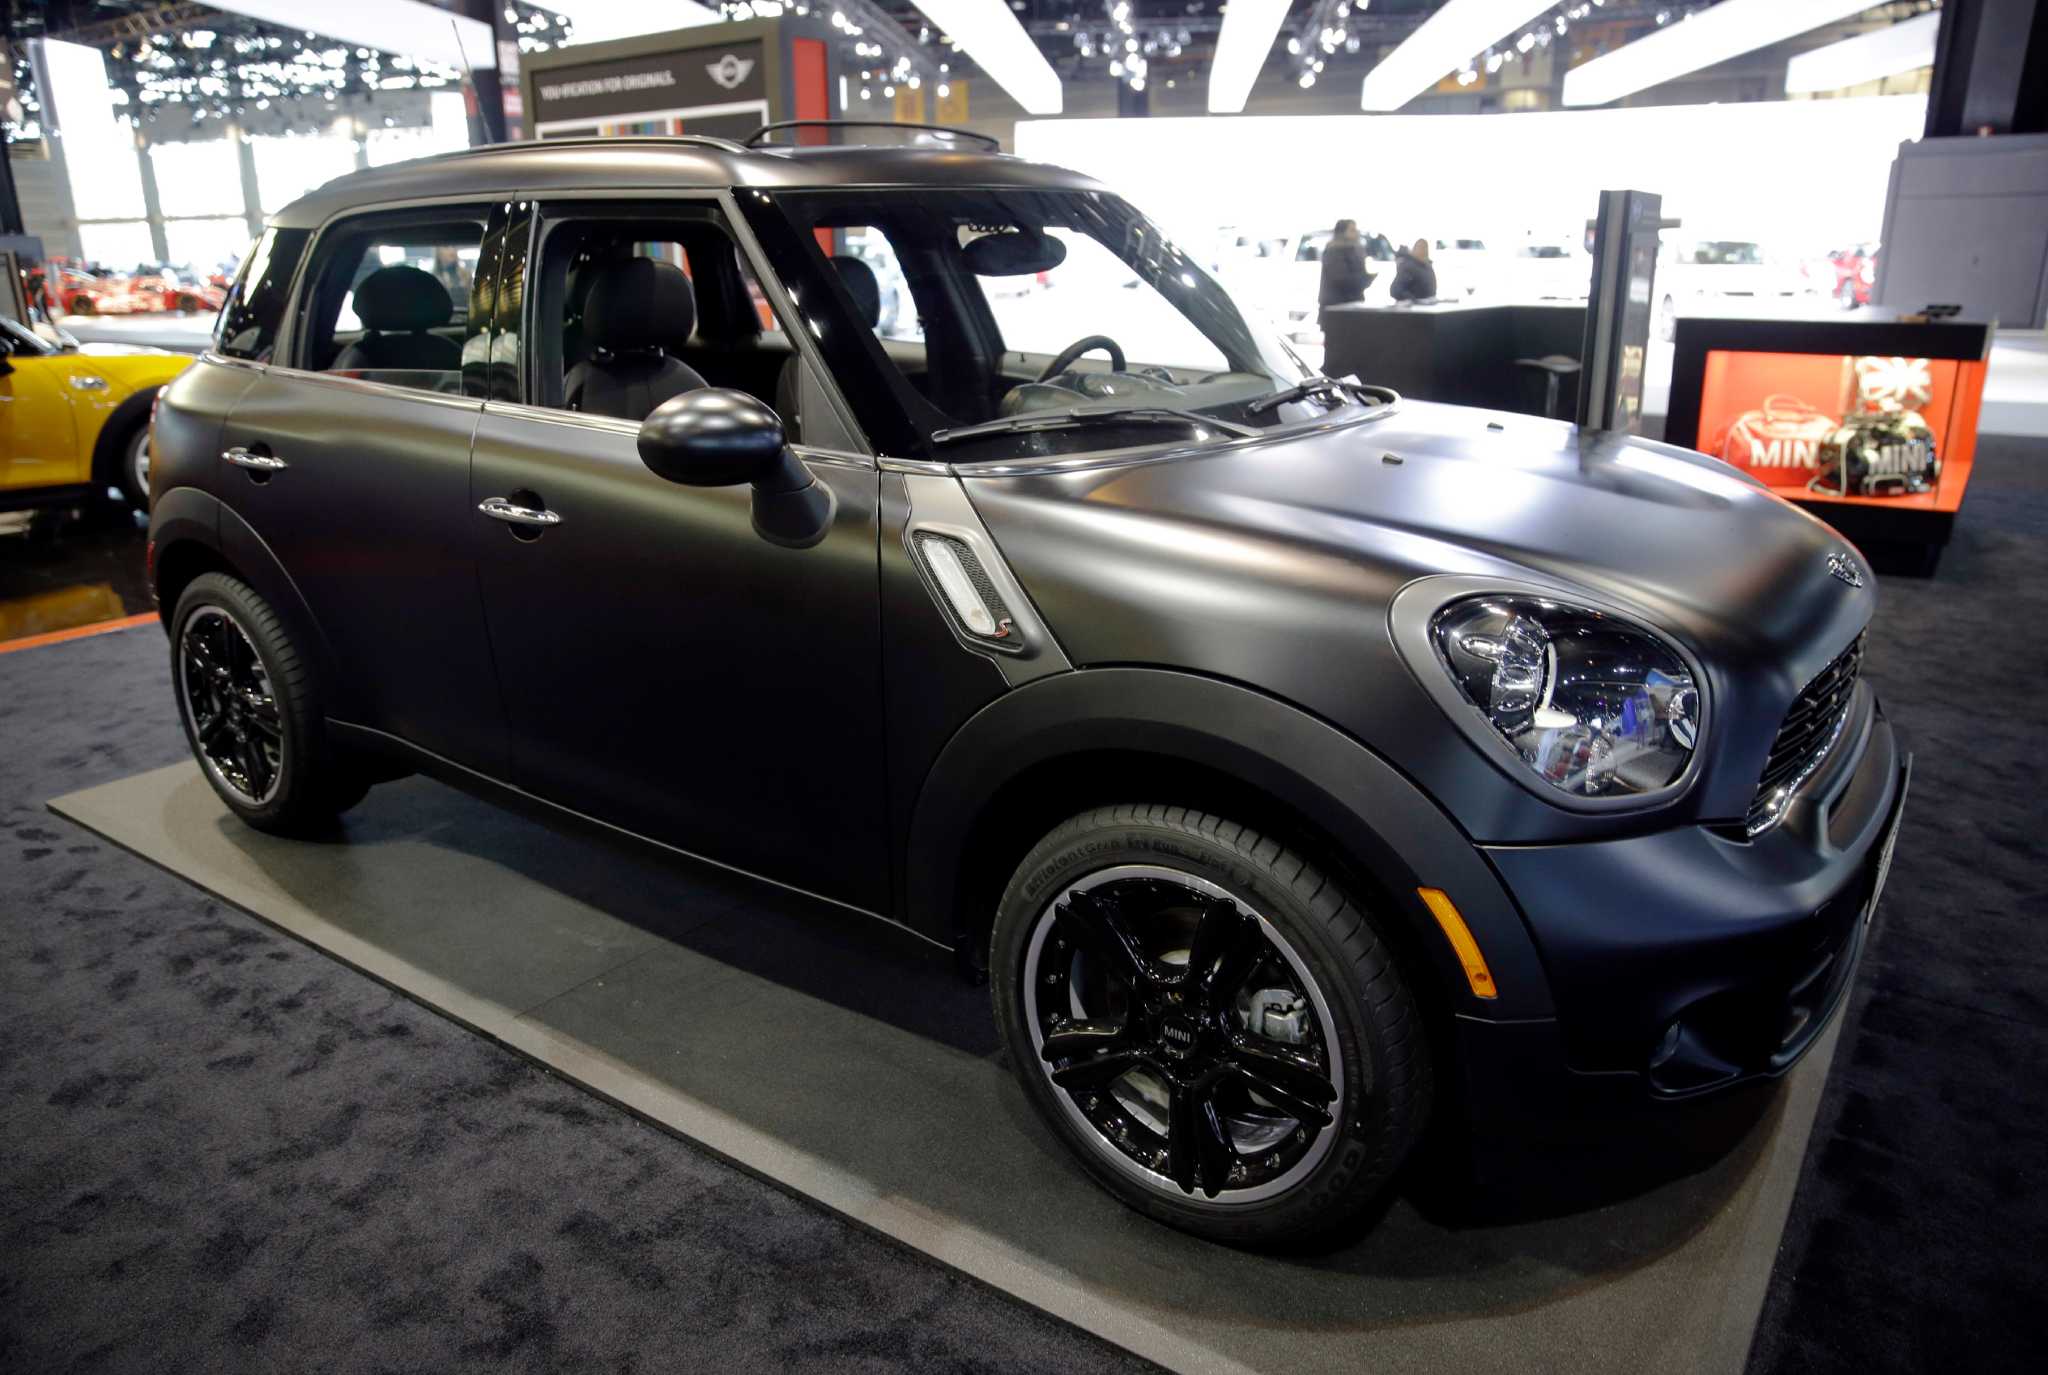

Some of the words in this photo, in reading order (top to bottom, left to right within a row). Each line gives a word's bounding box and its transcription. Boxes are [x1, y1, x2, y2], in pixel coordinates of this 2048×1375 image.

[604, 76, 622, 93] FOR
[1750, 438, 1819, 469] MIN
[1868, 443, 1928, 475] MINI
[1164, 1025, 1190, 1043] MINI
